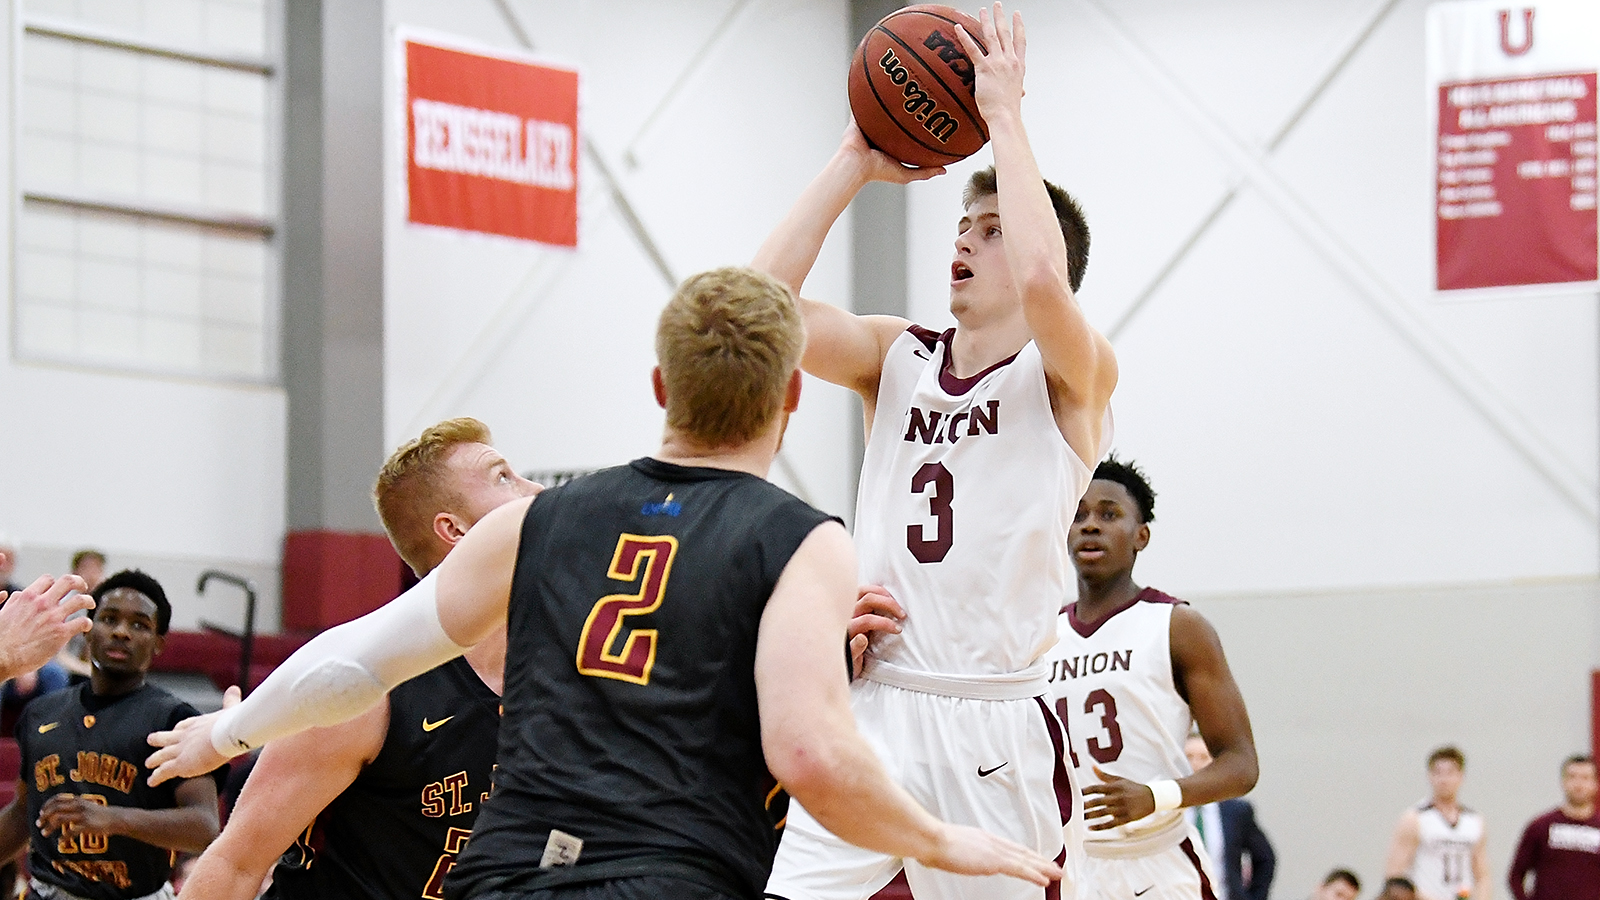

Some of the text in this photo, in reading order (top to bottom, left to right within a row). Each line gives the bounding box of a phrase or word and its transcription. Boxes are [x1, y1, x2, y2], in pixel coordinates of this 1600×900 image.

[1498, 8, 1534, 57] U
[922, 30, 976, 97] CAA
[879, 48, 959, 144] Wilson
[902, 399, 1000, 445] NION
[906, 461, 953, 563] 3
[576, 533, 679, 686] 2
[69, 750, 138, 795] JOHN
[421, 770, 472, 818] ST.
